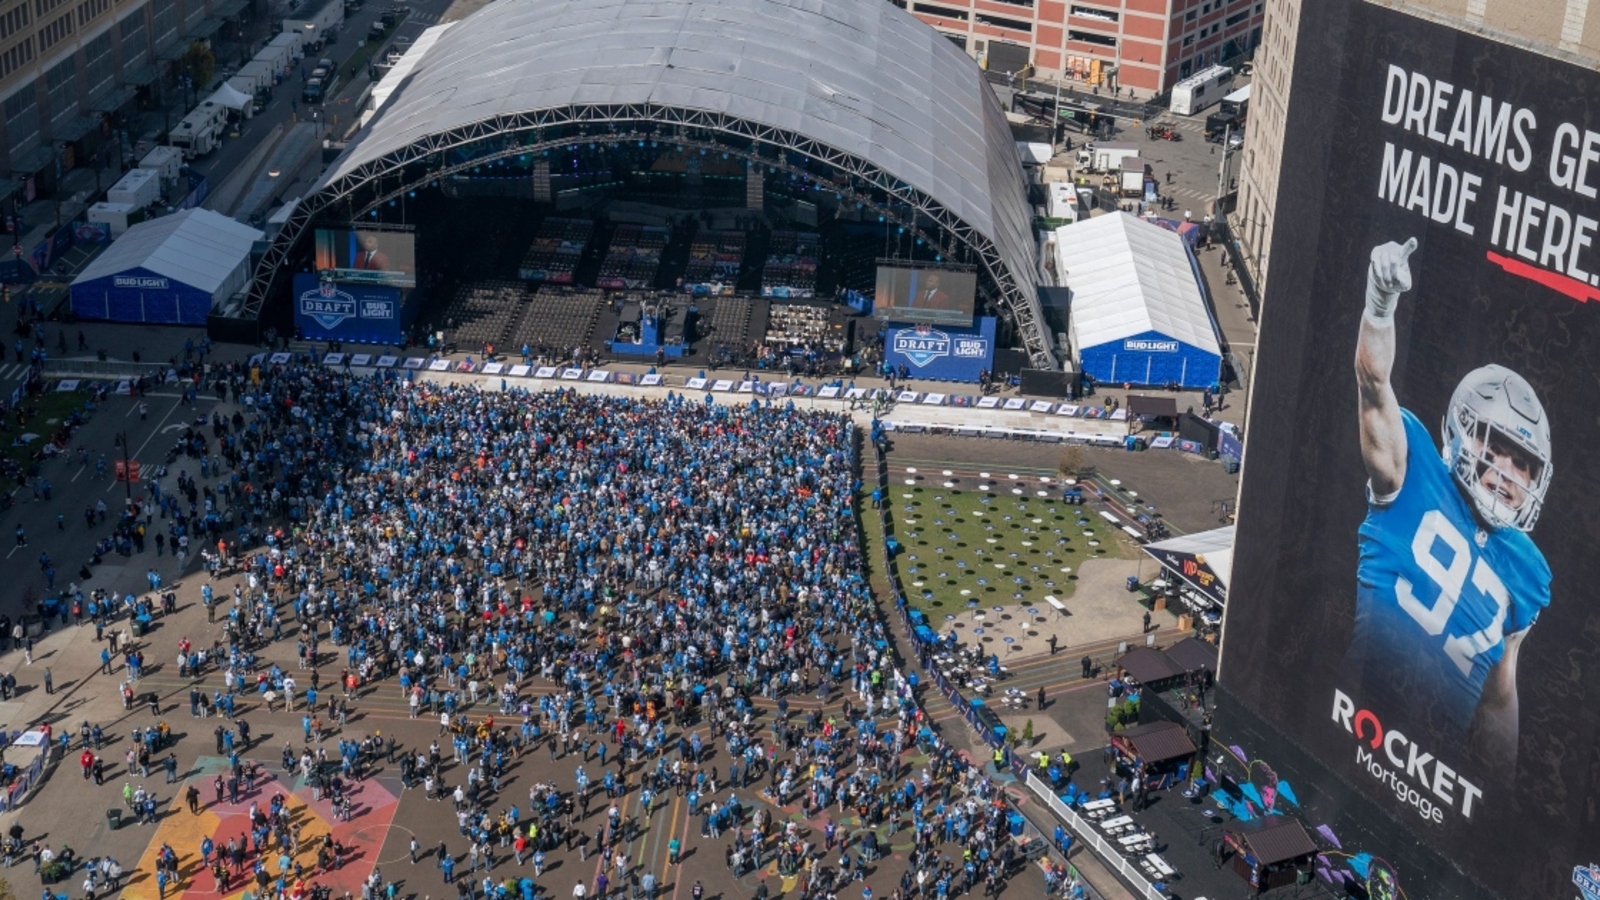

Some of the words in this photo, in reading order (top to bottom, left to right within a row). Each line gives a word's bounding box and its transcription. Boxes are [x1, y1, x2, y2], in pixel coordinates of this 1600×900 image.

[1381, 64, 1537, 172] DREAMS
[1377, 142, 1483, 236] MADE
[1490, 185, 1600, 287] HERE.
[137, 279, 165, 287] LIGHT
[305, 301, 352, 313] DRAFT
[366, 302, 387, 310] BUD
[362, 309, 391, 317] LIGHT
[898, 339, 945, 351] DRAFT
[960, 340, 981, 349] BUD
[1147, 342, 1177, 350] LIGHT
[956, 347, 984, 357] LIGHT
[1331, 688, 1483, 818] ROCKET
[1356, 745, 1444, 823] Mortgage
